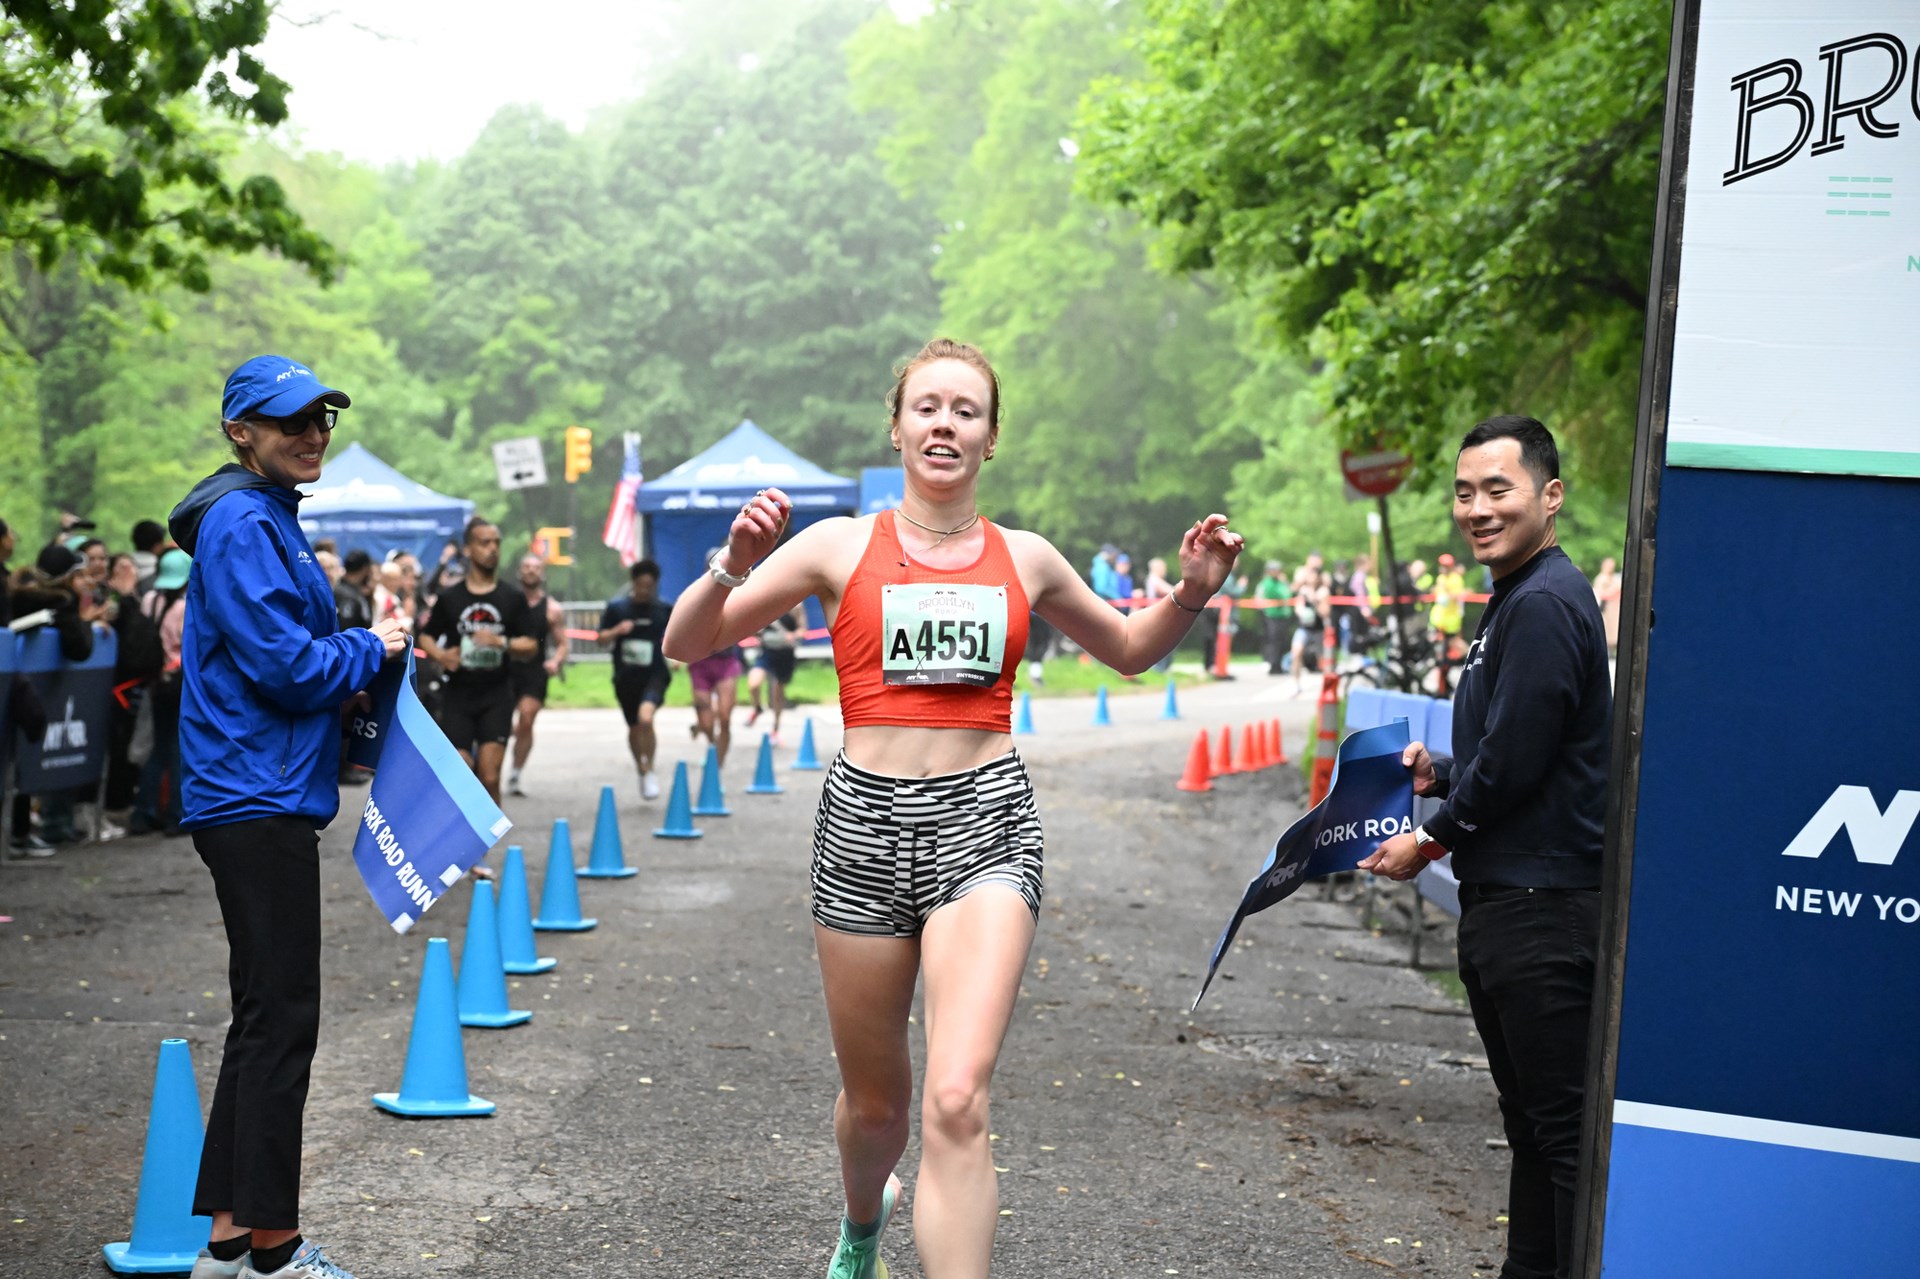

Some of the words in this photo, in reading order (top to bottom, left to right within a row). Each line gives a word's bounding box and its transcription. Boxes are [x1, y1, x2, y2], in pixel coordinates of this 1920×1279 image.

[1722, 32, 1920, 187] BR
[918, 596, 975, 611] BROOKLYN
[363, 792, 386, 835] ORK
[375, 825, 405, 867] ROAD
[1314, 821, 1358, 850] YORK
[1775, 885, 1863, 917] NEW
[1872, 894, 1920, 923] YO
